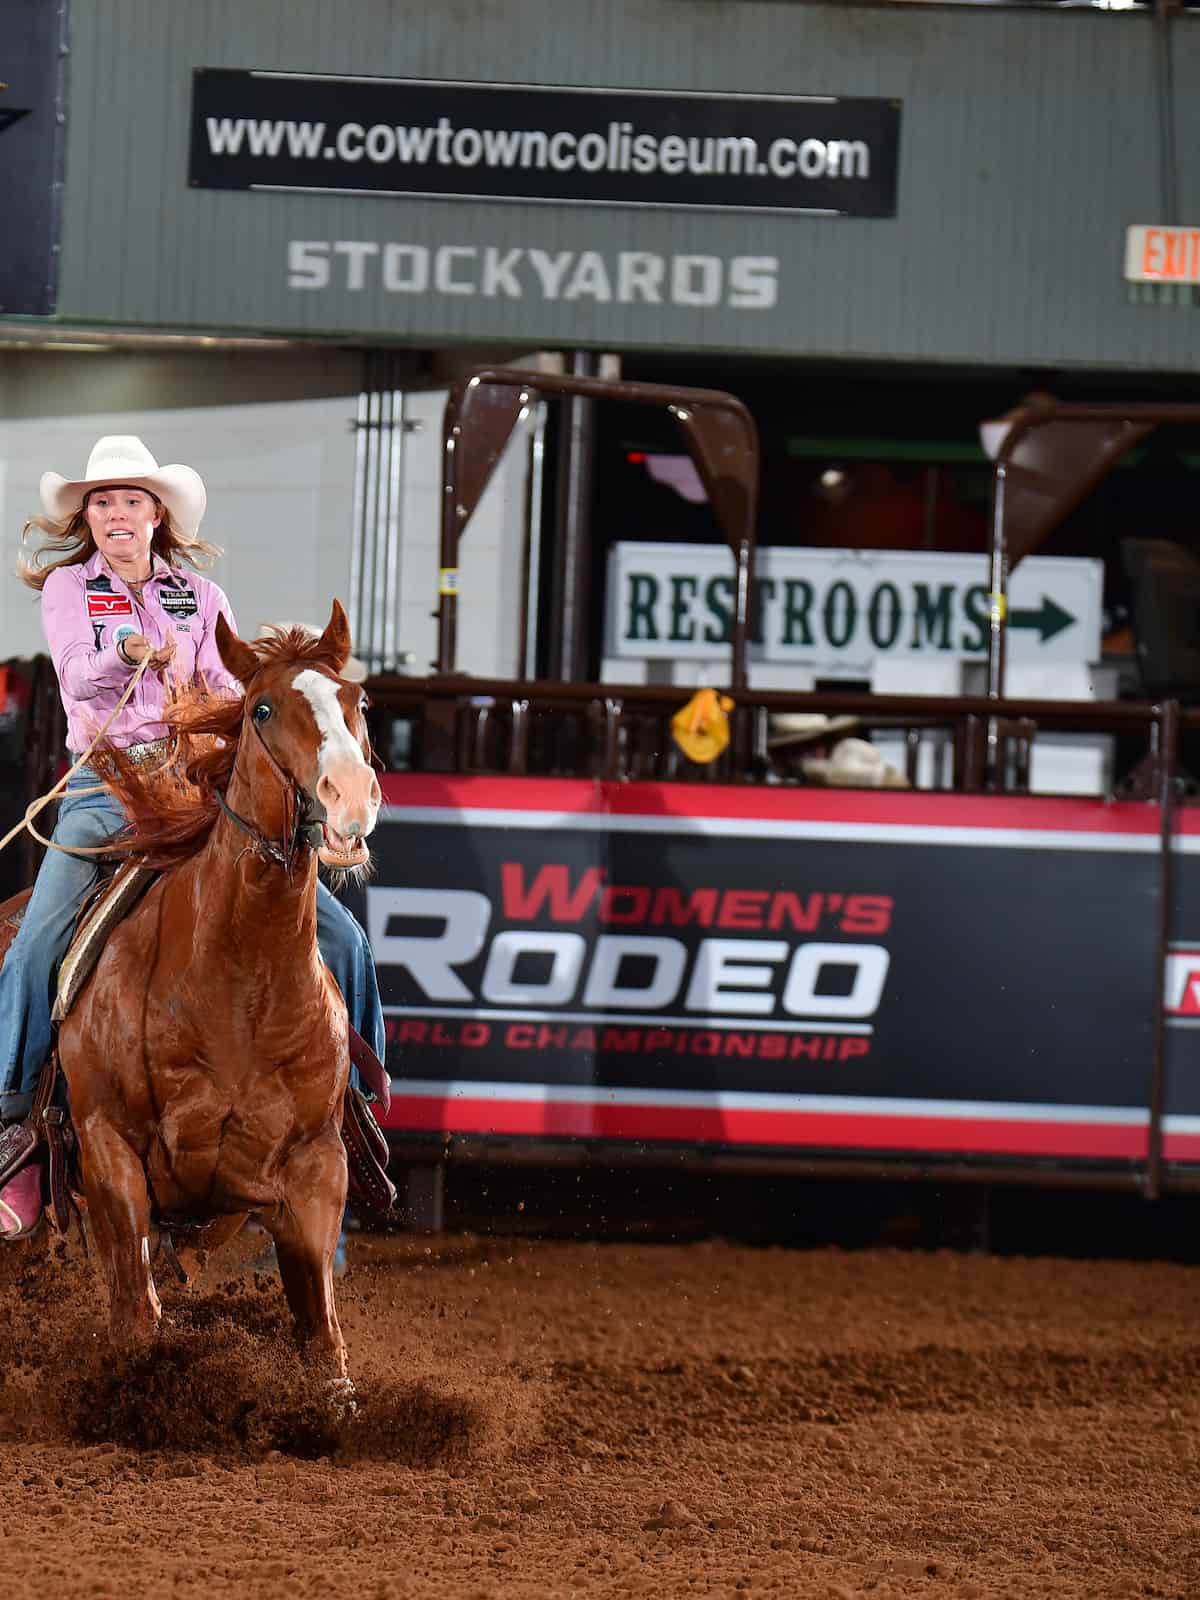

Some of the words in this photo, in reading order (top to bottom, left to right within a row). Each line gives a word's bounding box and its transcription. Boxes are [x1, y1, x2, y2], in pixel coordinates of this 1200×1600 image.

[206, 116, 871, 179] www.cowtowncoliseum.com
[287, 240, 780, 309] STOCKYARDS
[625, 572, 990, 652] RESTROOMS
[499, 862, 895, 934] WOMEN'S
[367, 886, 891, 1019] RODEO
[504, 1023, 872, 1061] CHAMPIONSHIP
